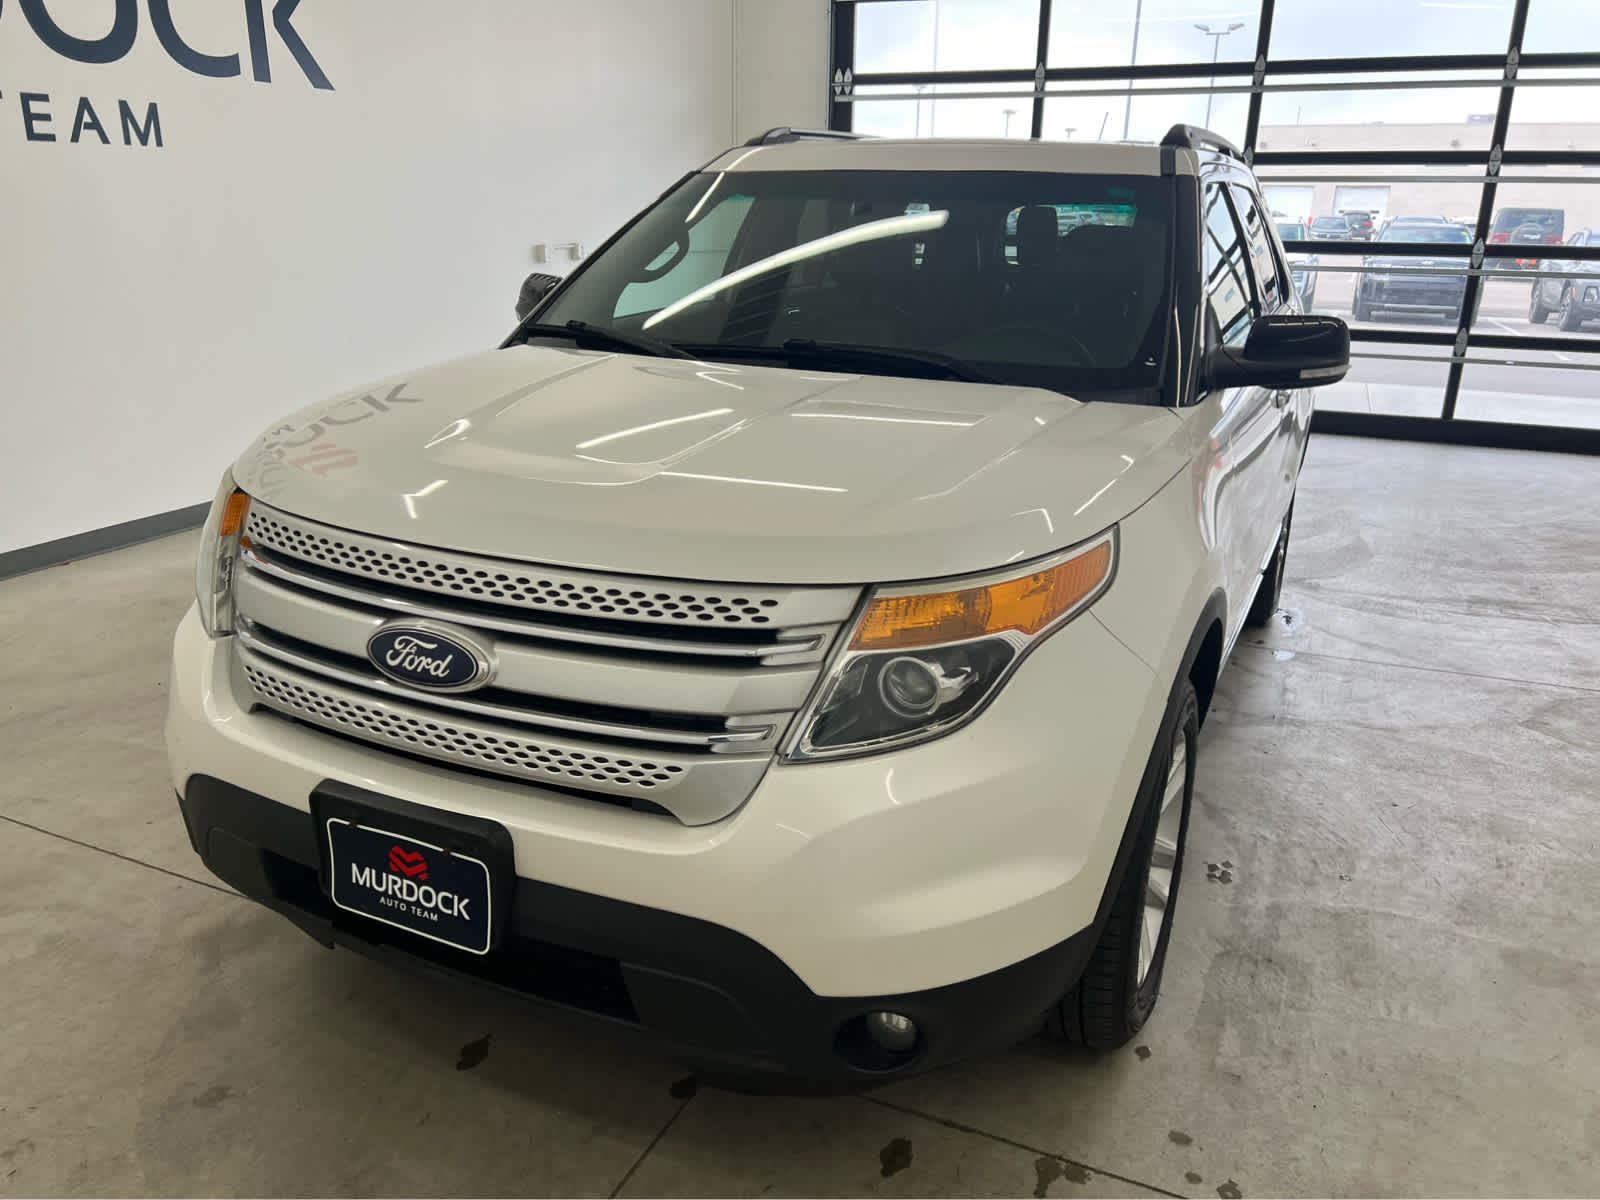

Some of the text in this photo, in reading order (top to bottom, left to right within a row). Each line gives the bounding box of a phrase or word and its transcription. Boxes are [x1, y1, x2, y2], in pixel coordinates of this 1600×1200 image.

[0, 89, 164, 148] EAM
[386, 635, 453, 677] Ford
[351, 862, 470, 920] MURDOCK
[379, 896, 438, 921] AUTO TEAM
